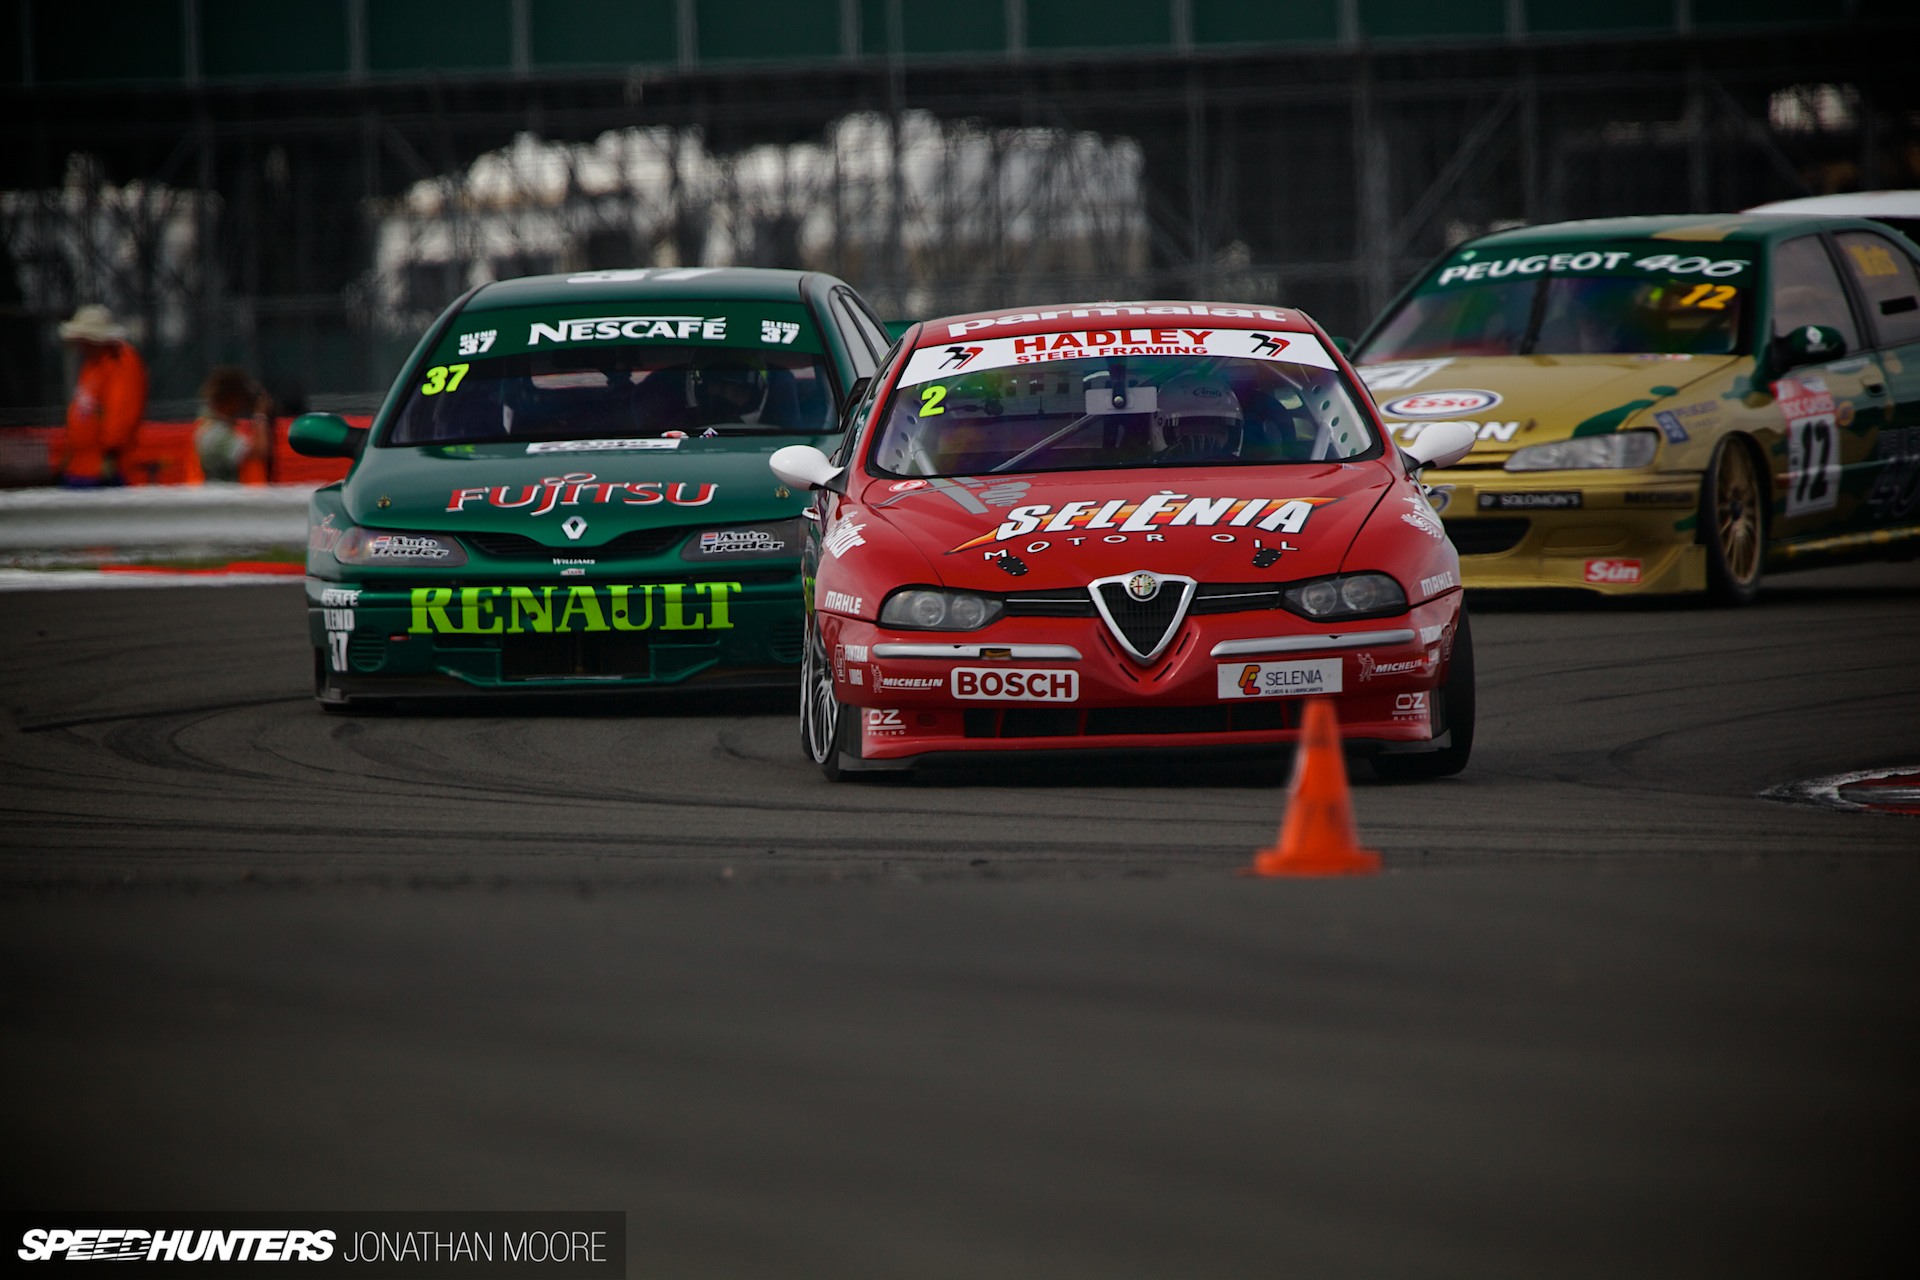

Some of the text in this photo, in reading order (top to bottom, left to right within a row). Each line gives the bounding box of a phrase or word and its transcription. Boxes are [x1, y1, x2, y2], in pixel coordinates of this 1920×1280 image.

[1438, 251, 1752, 286] PEUGEOT 406
[1680, 283, 1737, 310] 12
[527, 316, 728, 346] NESCAFÉ
[948, 304, 1287, 338] parmalat
[458, 336, 498, 356] 37
[760, 327, 800, 345] 37
[1014, 328, 1214, 354] HADLEY
[1016, 345, 1208, 365] STEEL FRAMING
[421, 363, 470, 396] 37
[919, 385, 947, 418] 2
[445, 472, 719, 516] FUJITSU
[393, 536, 438, 548] Auto
[702, 541, 784, 553] Trader
[720, 530, 769, 541] Auto
[983, 533, 1299, 561] MOTOR OIL
[1420, 571, 1454, 597] MAHLE
[407, 582, 742, 634] RENAULT
[824, 590, 862, 614] MAHLE
[883, 678, 943, 687] MICHELIN
[957, 671, 1072, 698] BOSCH
[1265, 669, 1322, 687] SELENIA
